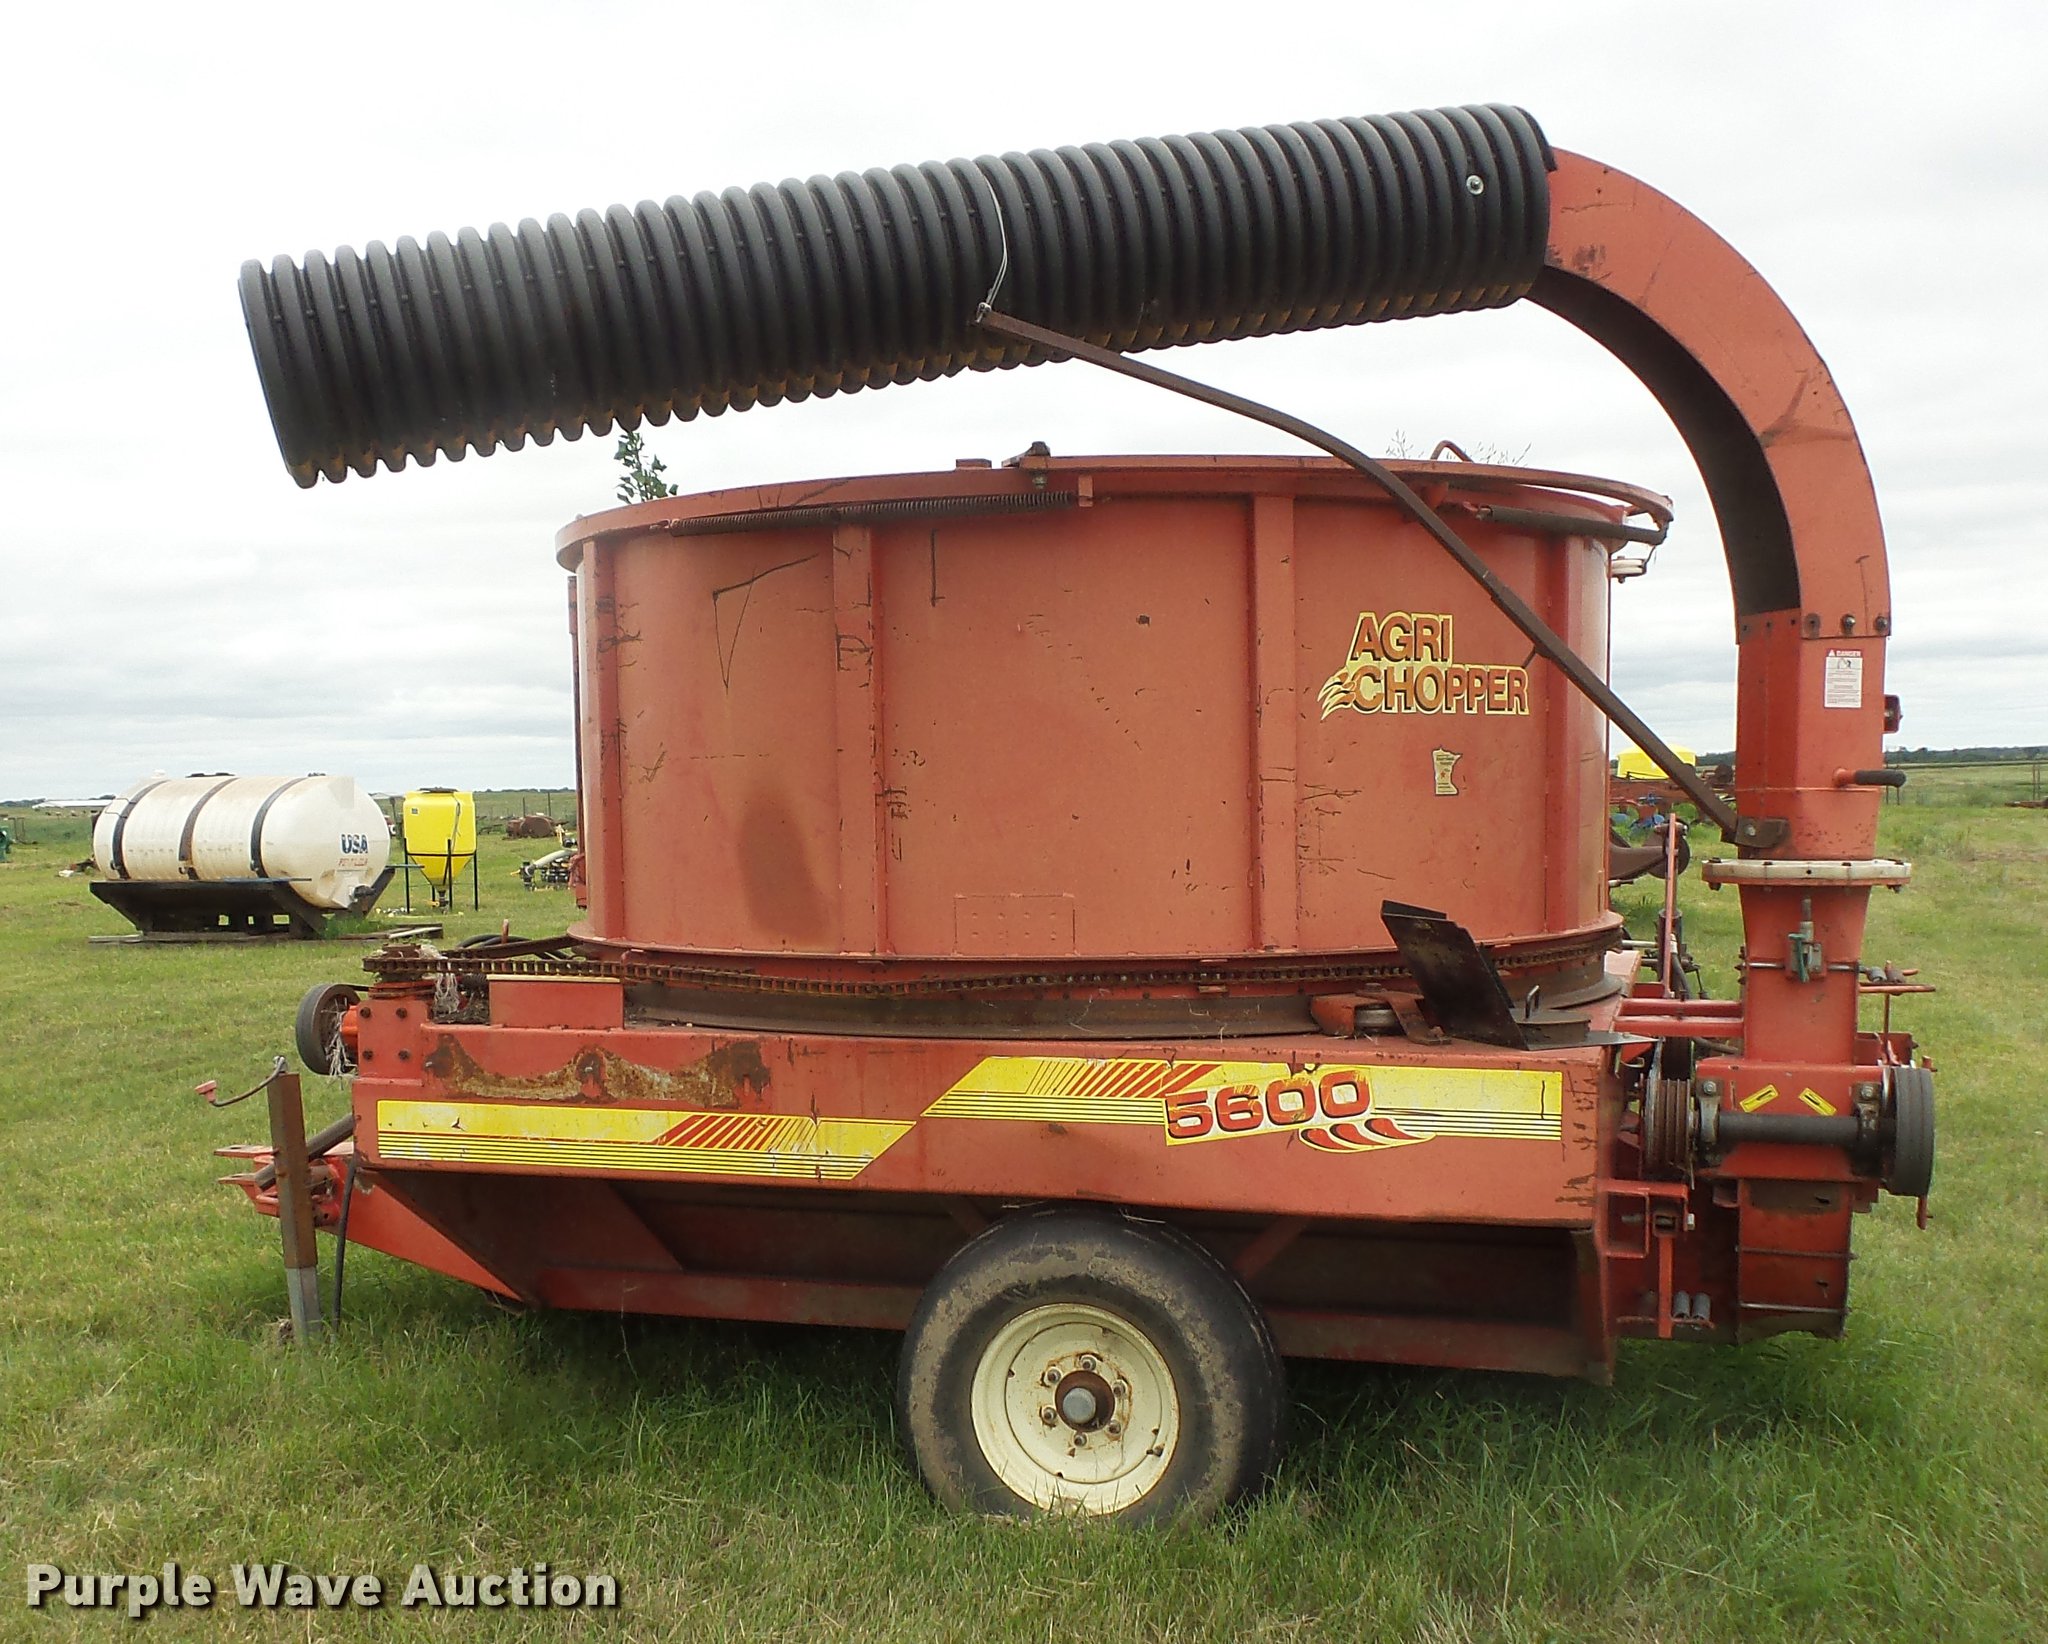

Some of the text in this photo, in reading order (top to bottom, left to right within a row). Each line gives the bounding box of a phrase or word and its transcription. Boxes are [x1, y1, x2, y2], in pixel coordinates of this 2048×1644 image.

[1349, 613, 1453, 663] AGRI
[1350, 665, 1529, 713] CHOPPER
[340, 833, 369, 854] USA
[1166, 1069, 1371, 1139] 5600
